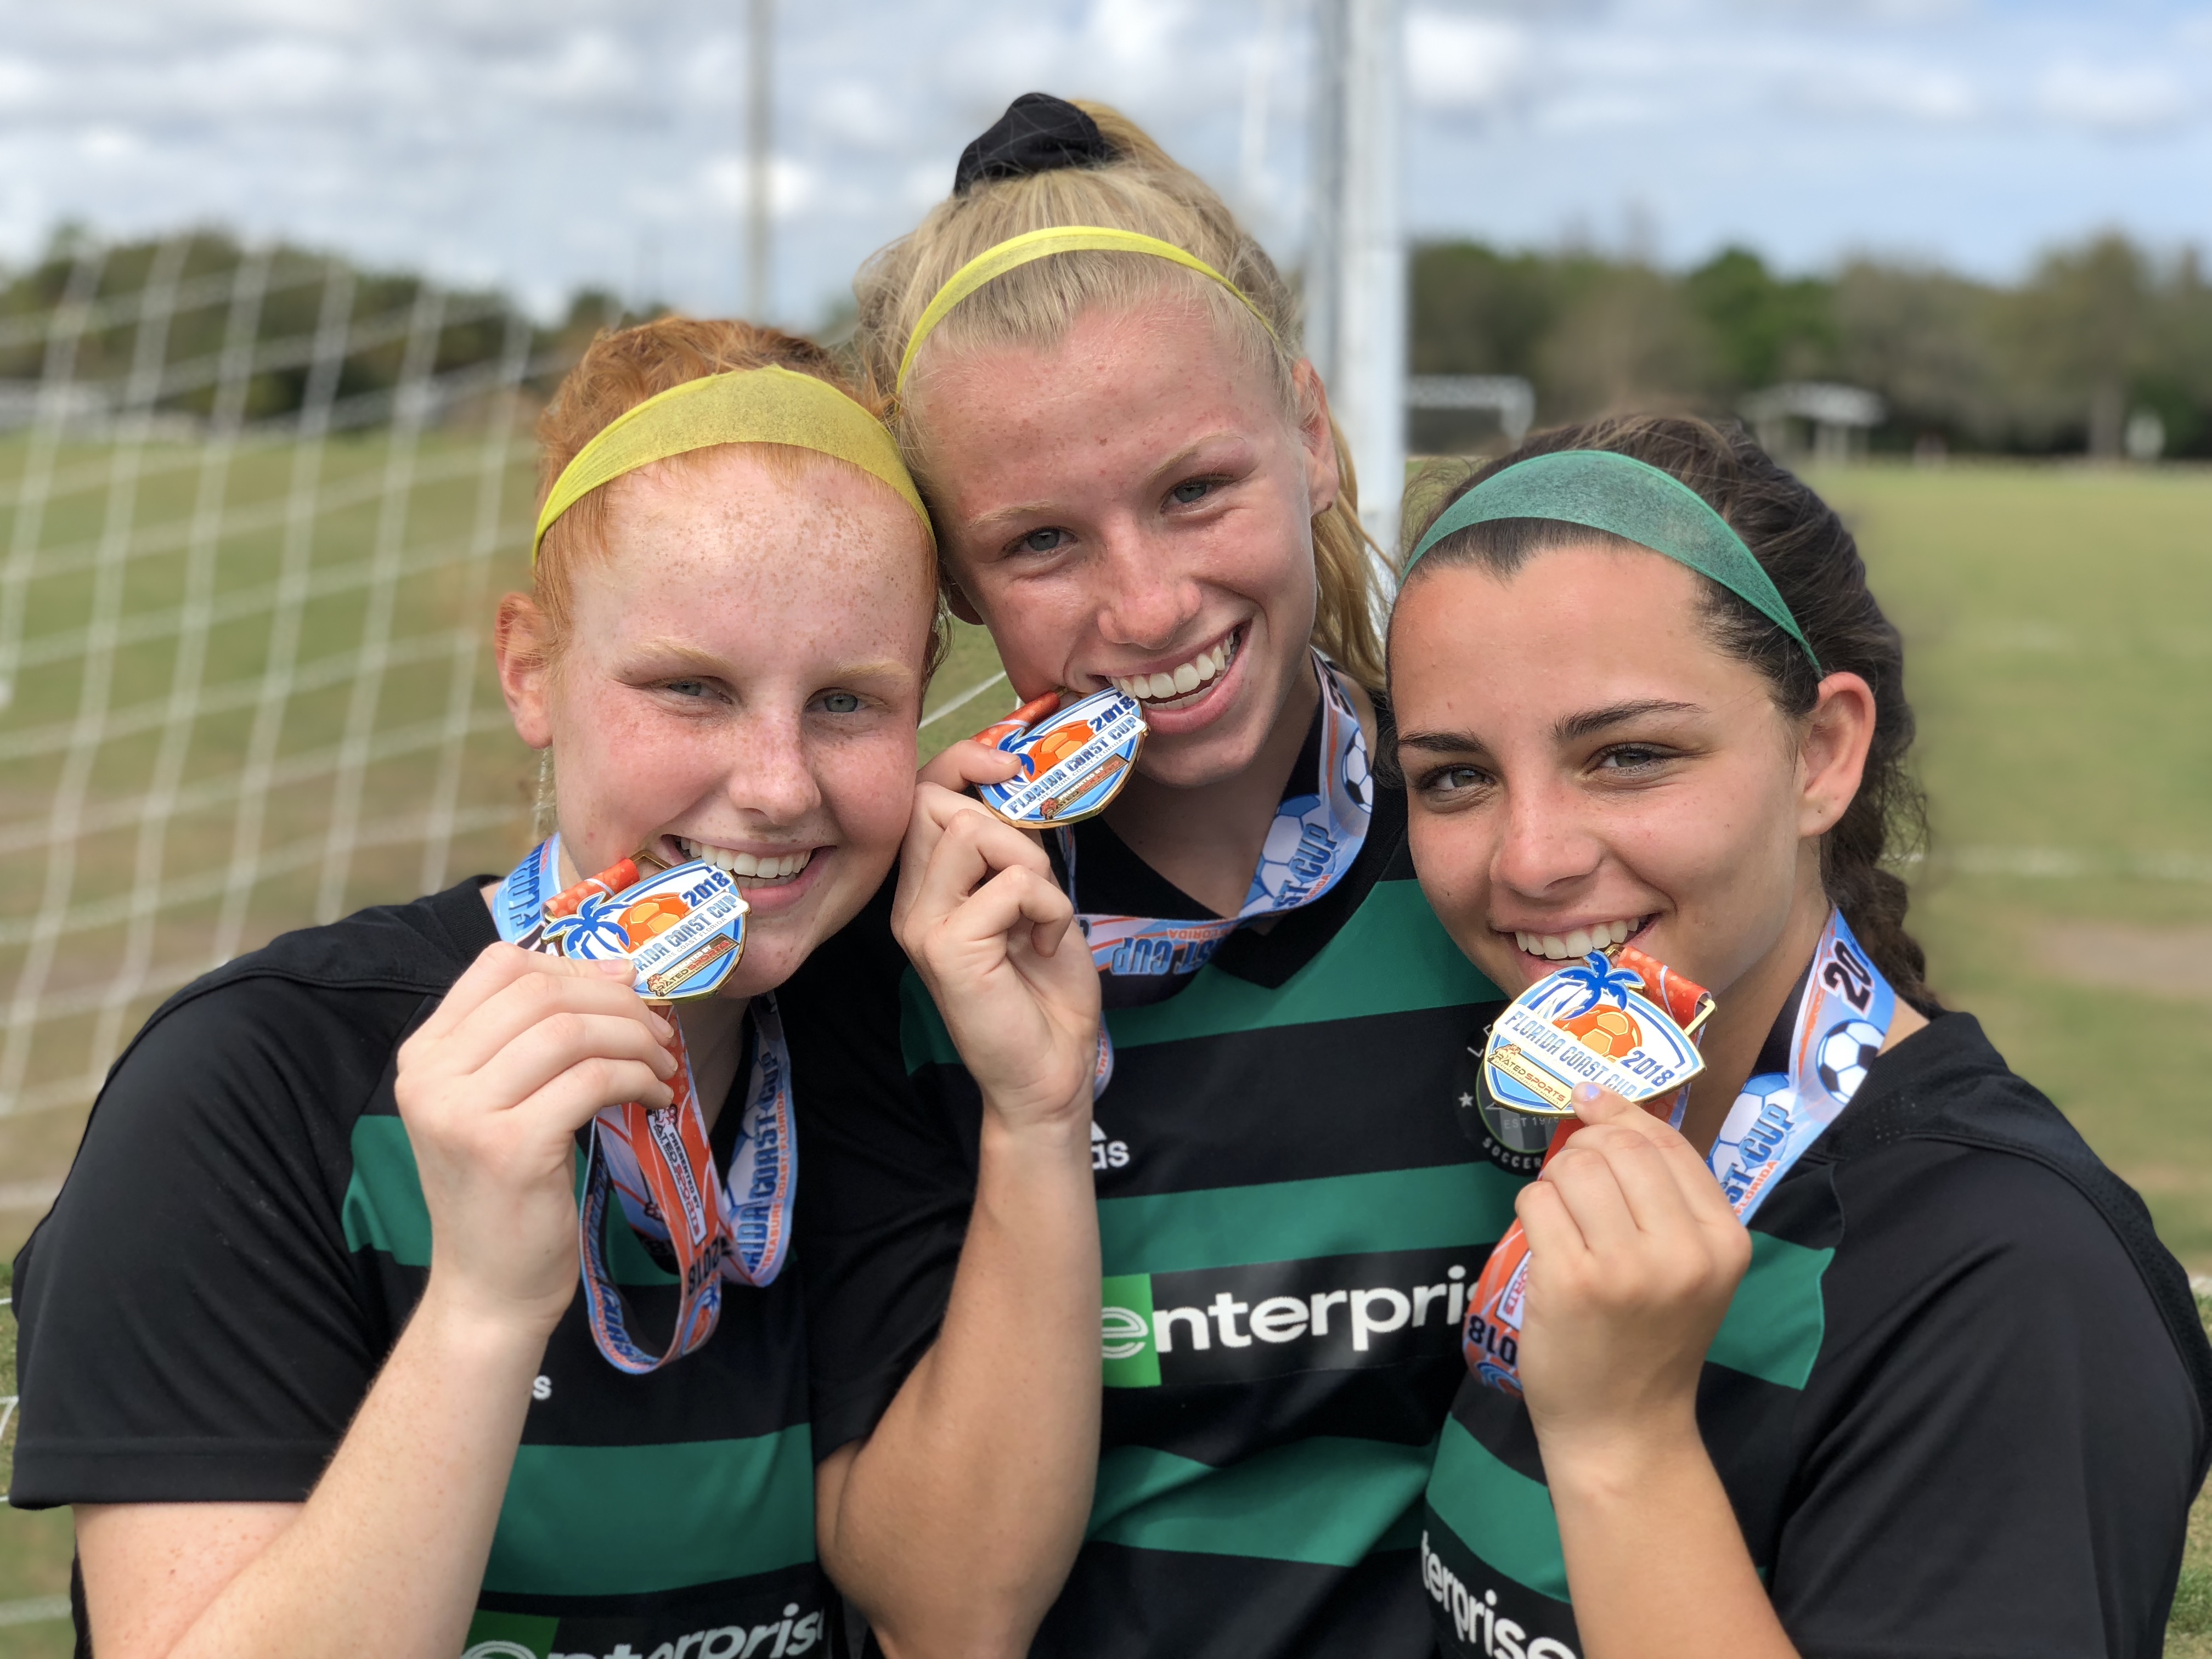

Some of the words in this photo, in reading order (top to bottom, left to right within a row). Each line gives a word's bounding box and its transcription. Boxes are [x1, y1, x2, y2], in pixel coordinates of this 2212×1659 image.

[1090, 696, 1136, 732] 2018
[1006, 769, 1068, 814] FLORIDA
[1064, 737, 1110, 772] COAST
[1108, 716, 1137, 740] CUP
[1036, 776, 1071, 802] TREASURE
[1097, 738, 1124, 759] FLORIDA
[1058, 774, 1094, 800] PRESENTED
[1096, 766, 1104, 774] BY
[1290, 822, 1338, 878] CUP
[681, 871, 731, 907] 2018
[631, 943, 670, 973] RIDA
[664, 913, 712, 947] COAST
[707, 895, 738, 918] CUP
[699, 918, 727, 937] FLORIDA
[701, 945, 712, 953] BY
[1111, 937, 1173, 975] CUP
[1504, 1011, 1566, 1055] FLORIDA
[1559, 1046, 1610, 1082] COAST
[1620, 1050, 1675, 1087] 2018
[758, 1051, 780, 1104] CUP
[1504, 1118, 1527, 1129] EST
[1739, 1103, 1795, 1163] CUP
[669, 1132, 695, 1194] PRESENTED
[692, 1194, 701, 1209] BY
[748, 1113, 779, 1200] COAST
[761, 1202, 784, 1268] TREASURE
[777, 1090, 788, 1150] FLORIDA
[1482, 1137, 1542, 1170] SOCCER
[740, 1206, 771, 1273] RIDA
[600, 1284, 662, 1364] COAST
[1102, 1265, 1477, 1360] enterpri
